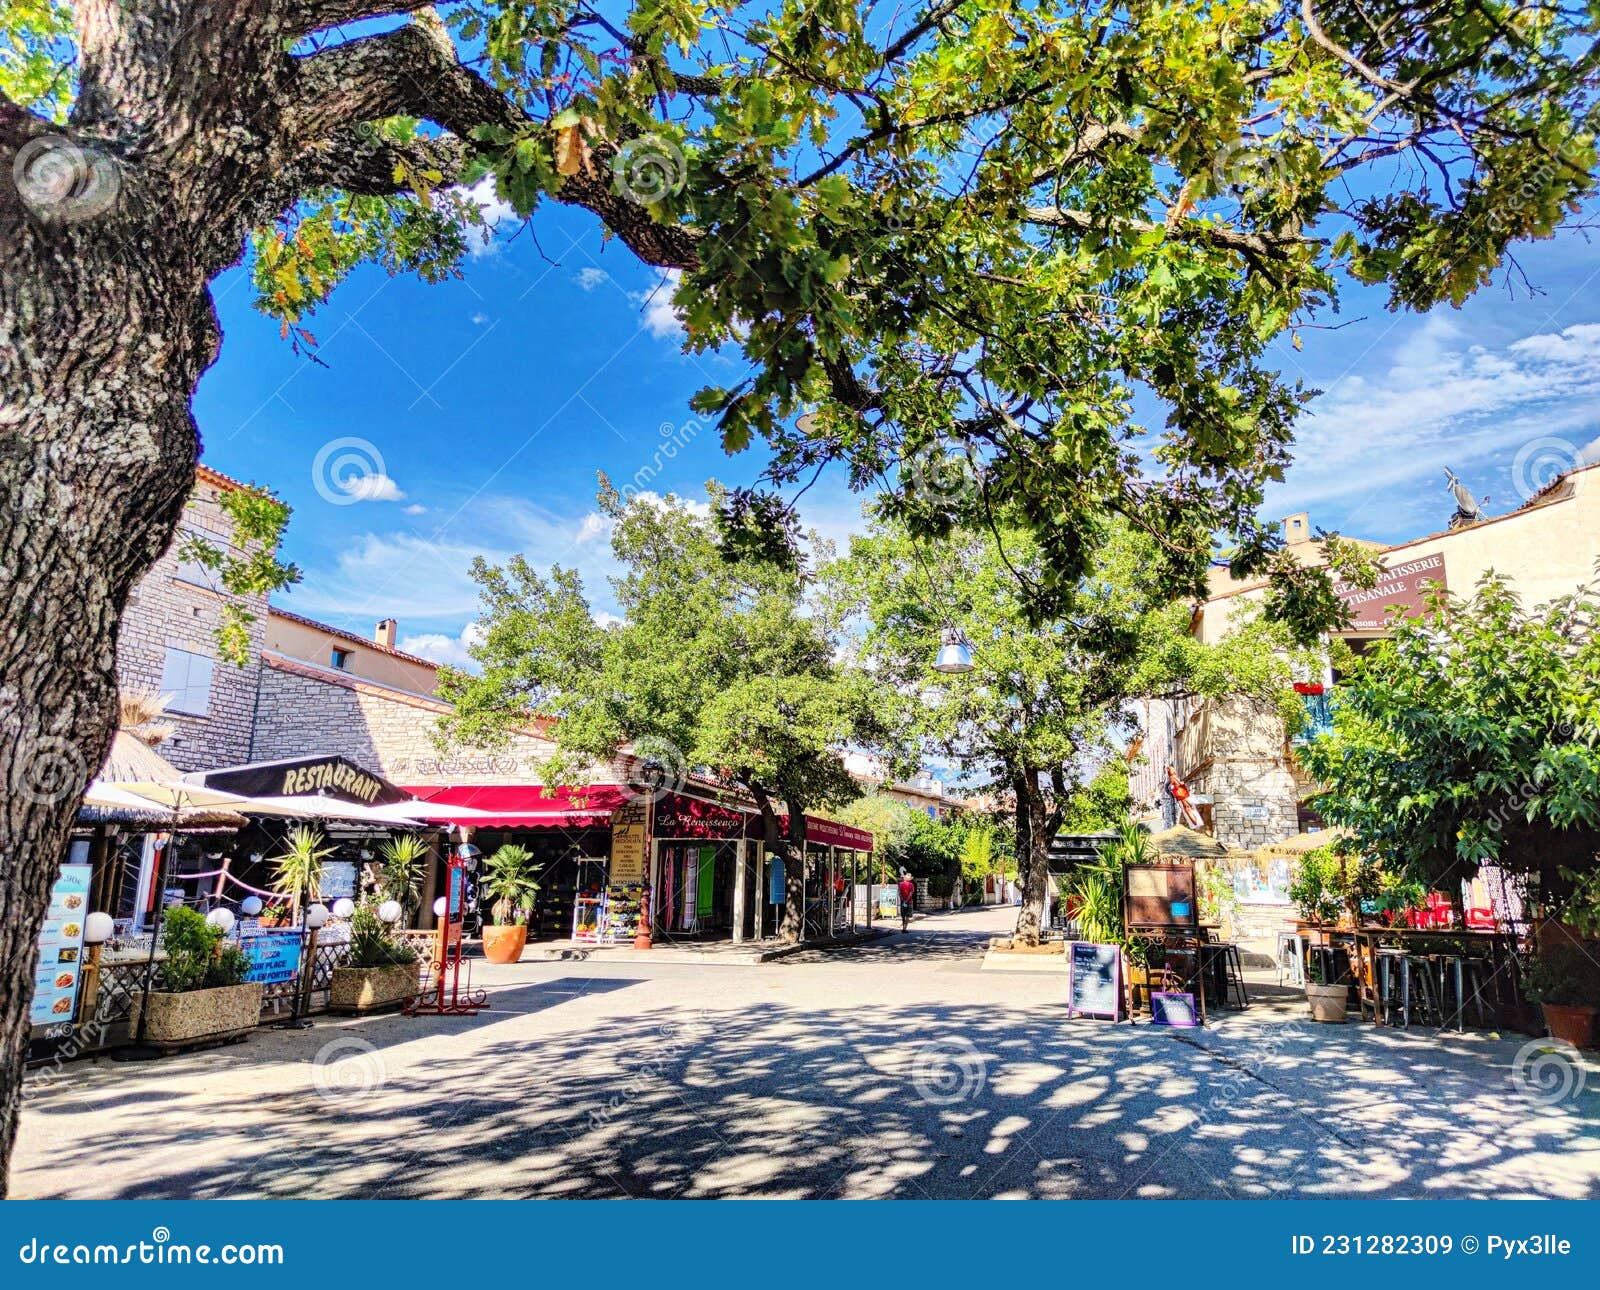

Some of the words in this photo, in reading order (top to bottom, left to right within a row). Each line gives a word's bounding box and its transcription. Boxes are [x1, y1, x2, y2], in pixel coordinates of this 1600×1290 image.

[1377, 556, 1443, 583] PATISSERIE
[282, 762, 382, 804] RESTAURANT
[658, 814, 676, 826] La
[265, 960, 288, 969] PLACE
